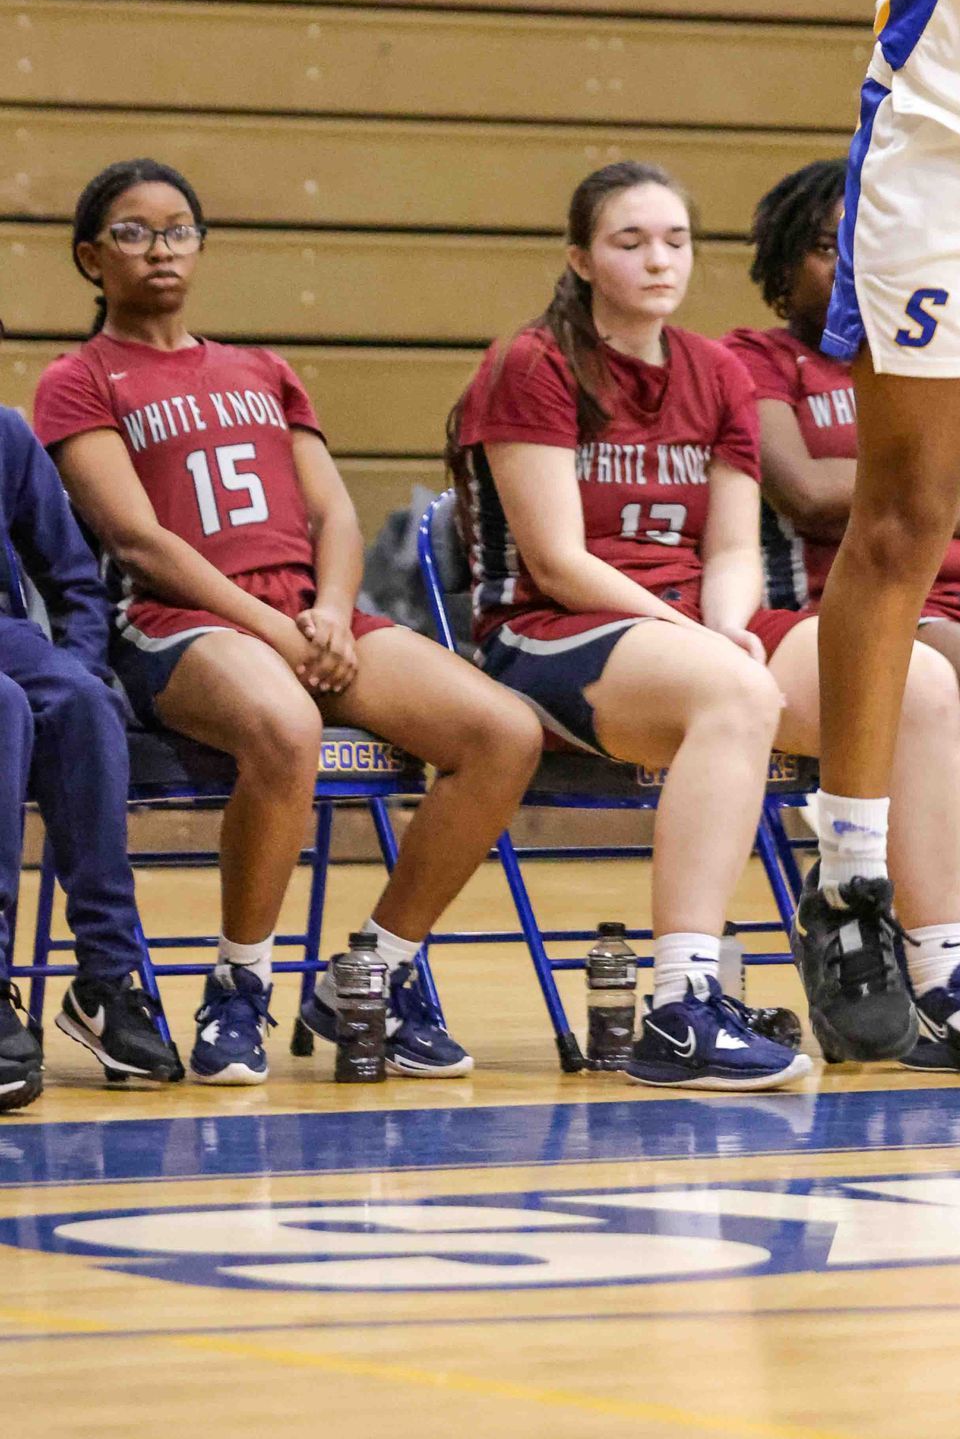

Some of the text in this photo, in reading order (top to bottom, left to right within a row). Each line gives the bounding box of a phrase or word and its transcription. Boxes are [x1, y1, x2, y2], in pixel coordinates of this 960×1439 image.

[894, 287, 950, 349] S
[122, 389, 288, 453] WHITE KNOLL
[807, 386, 857, 429] WHI
[186, 442, 270, 537] 15
[574, 441, 647, 485] WHITE
